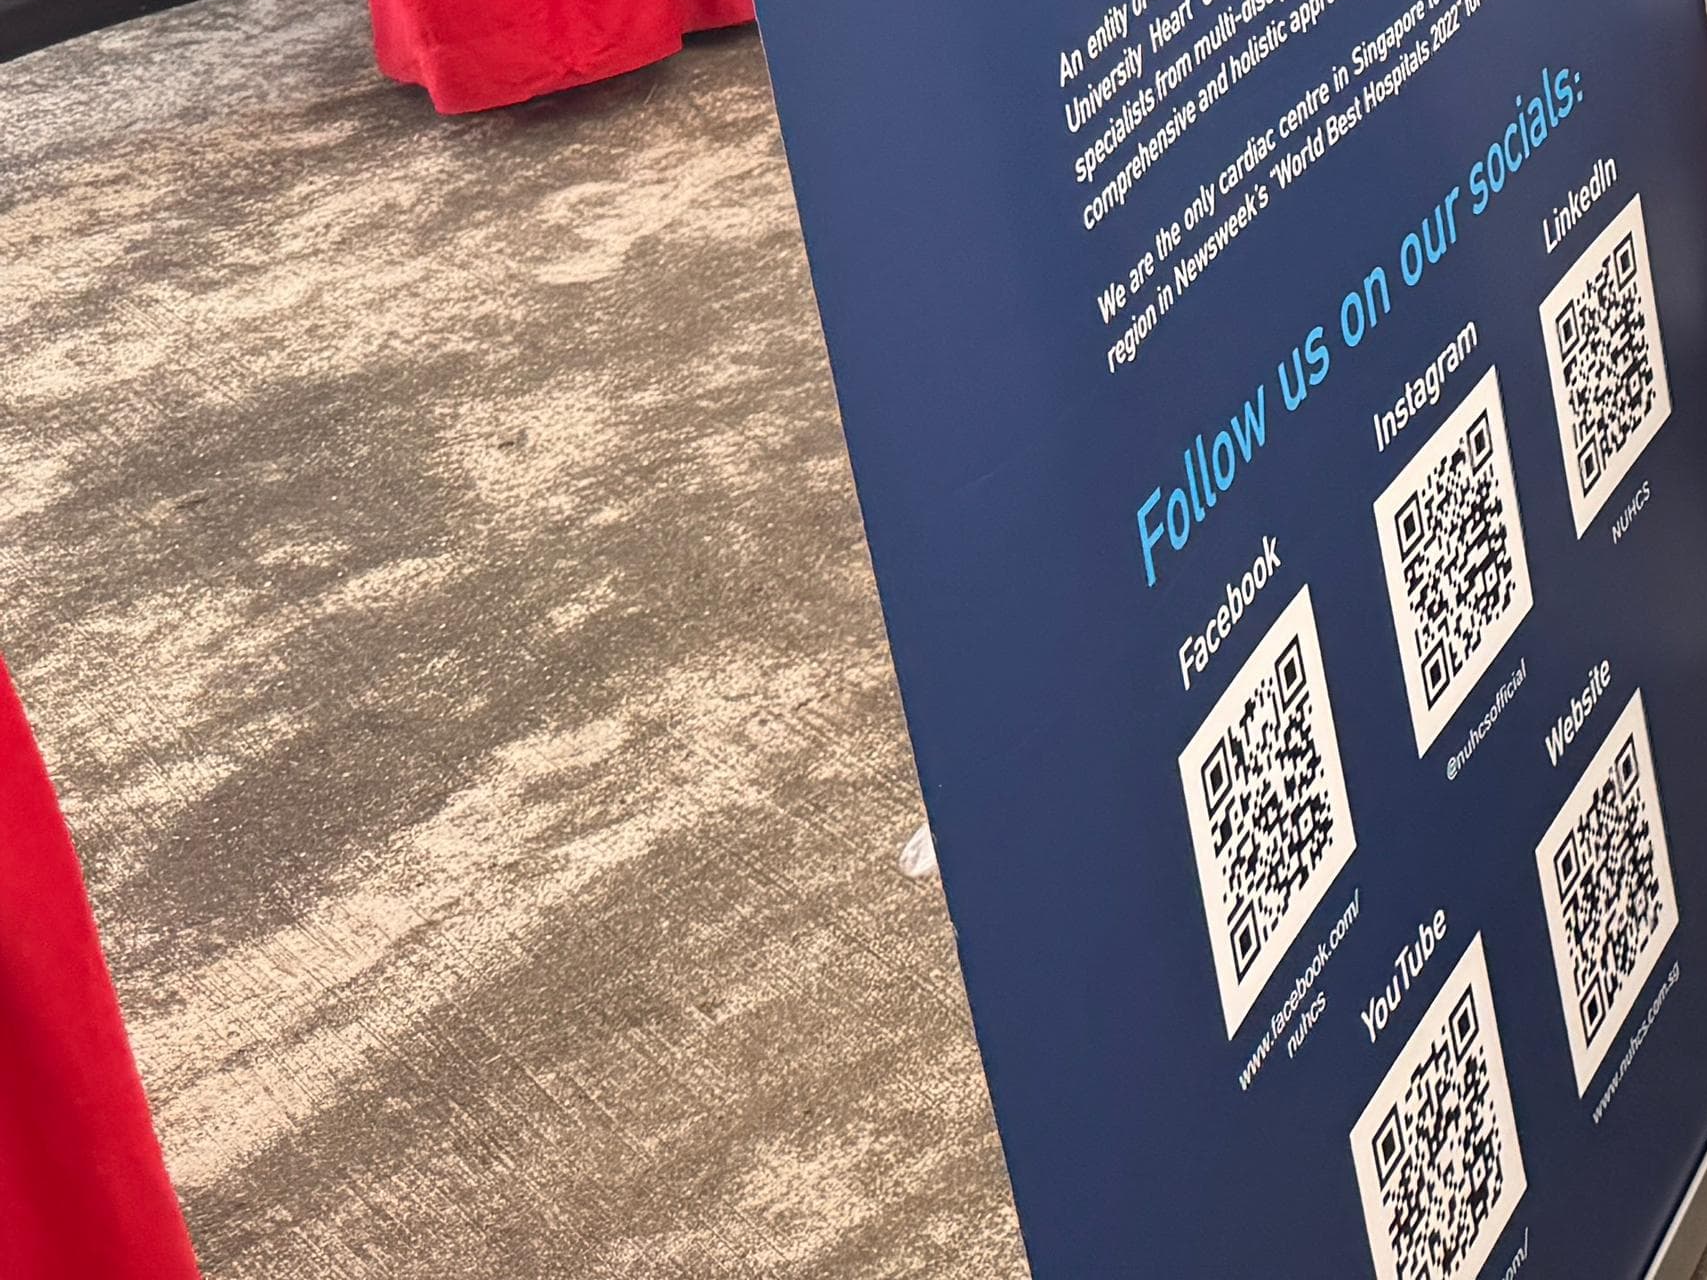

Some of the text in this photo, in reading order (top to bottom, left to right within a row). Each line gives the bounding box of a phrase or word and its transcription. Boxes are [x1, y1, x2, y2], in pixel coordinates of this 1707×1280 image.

[1059, 49, 1083, 87] An
[1087, 3, 1127, 58] entity
[1065, 44, 1142, 131] University
[1075, 88, 1154, 181] specialists
[1154, 52, 1192, 101] from
[1083, 101, 1195, 228] comprehensive
[1198, 62, 1228, 112] and
[1229, 20, 1287, 82] holistic
[1097, 282, 1126, 323] We
[1129, 251, 1154, 293] are
[1155, 222, 1181, 260] the
[1183, 183, 1214, 230] only
[1218, 128, 1275, 193] cardiac
[1278, 83, 1329, 137] centre
[1331, 65, 1349, 92] in
[1351, 0, 1424, 74] Singapore
[1107, 304, 1157, 372] region
[1156, 284, 1173, 314] in
[1325, 96, 1362, 145] Best
[1363, 40, 1429, 112] Hospitals
[1542, 154, 1617, 255] LinkedIn
[1136, 67, 1585, 588] Follow us on our socials:
[1373, 320, 1479, 453] Instagram
[1611, 479, 1652, 545] NUHCS
[1178, 534, 1282, 692] Facebook
[1446, 657, 1527, 781] @nuhcsofficial
[1545, 659, 1612, 767] Website
[1238, 887, 1360, 1091] www.facebook.com/
[1287, 991, 1326, 1059] nuhcs
[1360, 907, 1449, 1044] YouTube
[1592, 959, 1681, 1126] www.nuhcs.com.sg
